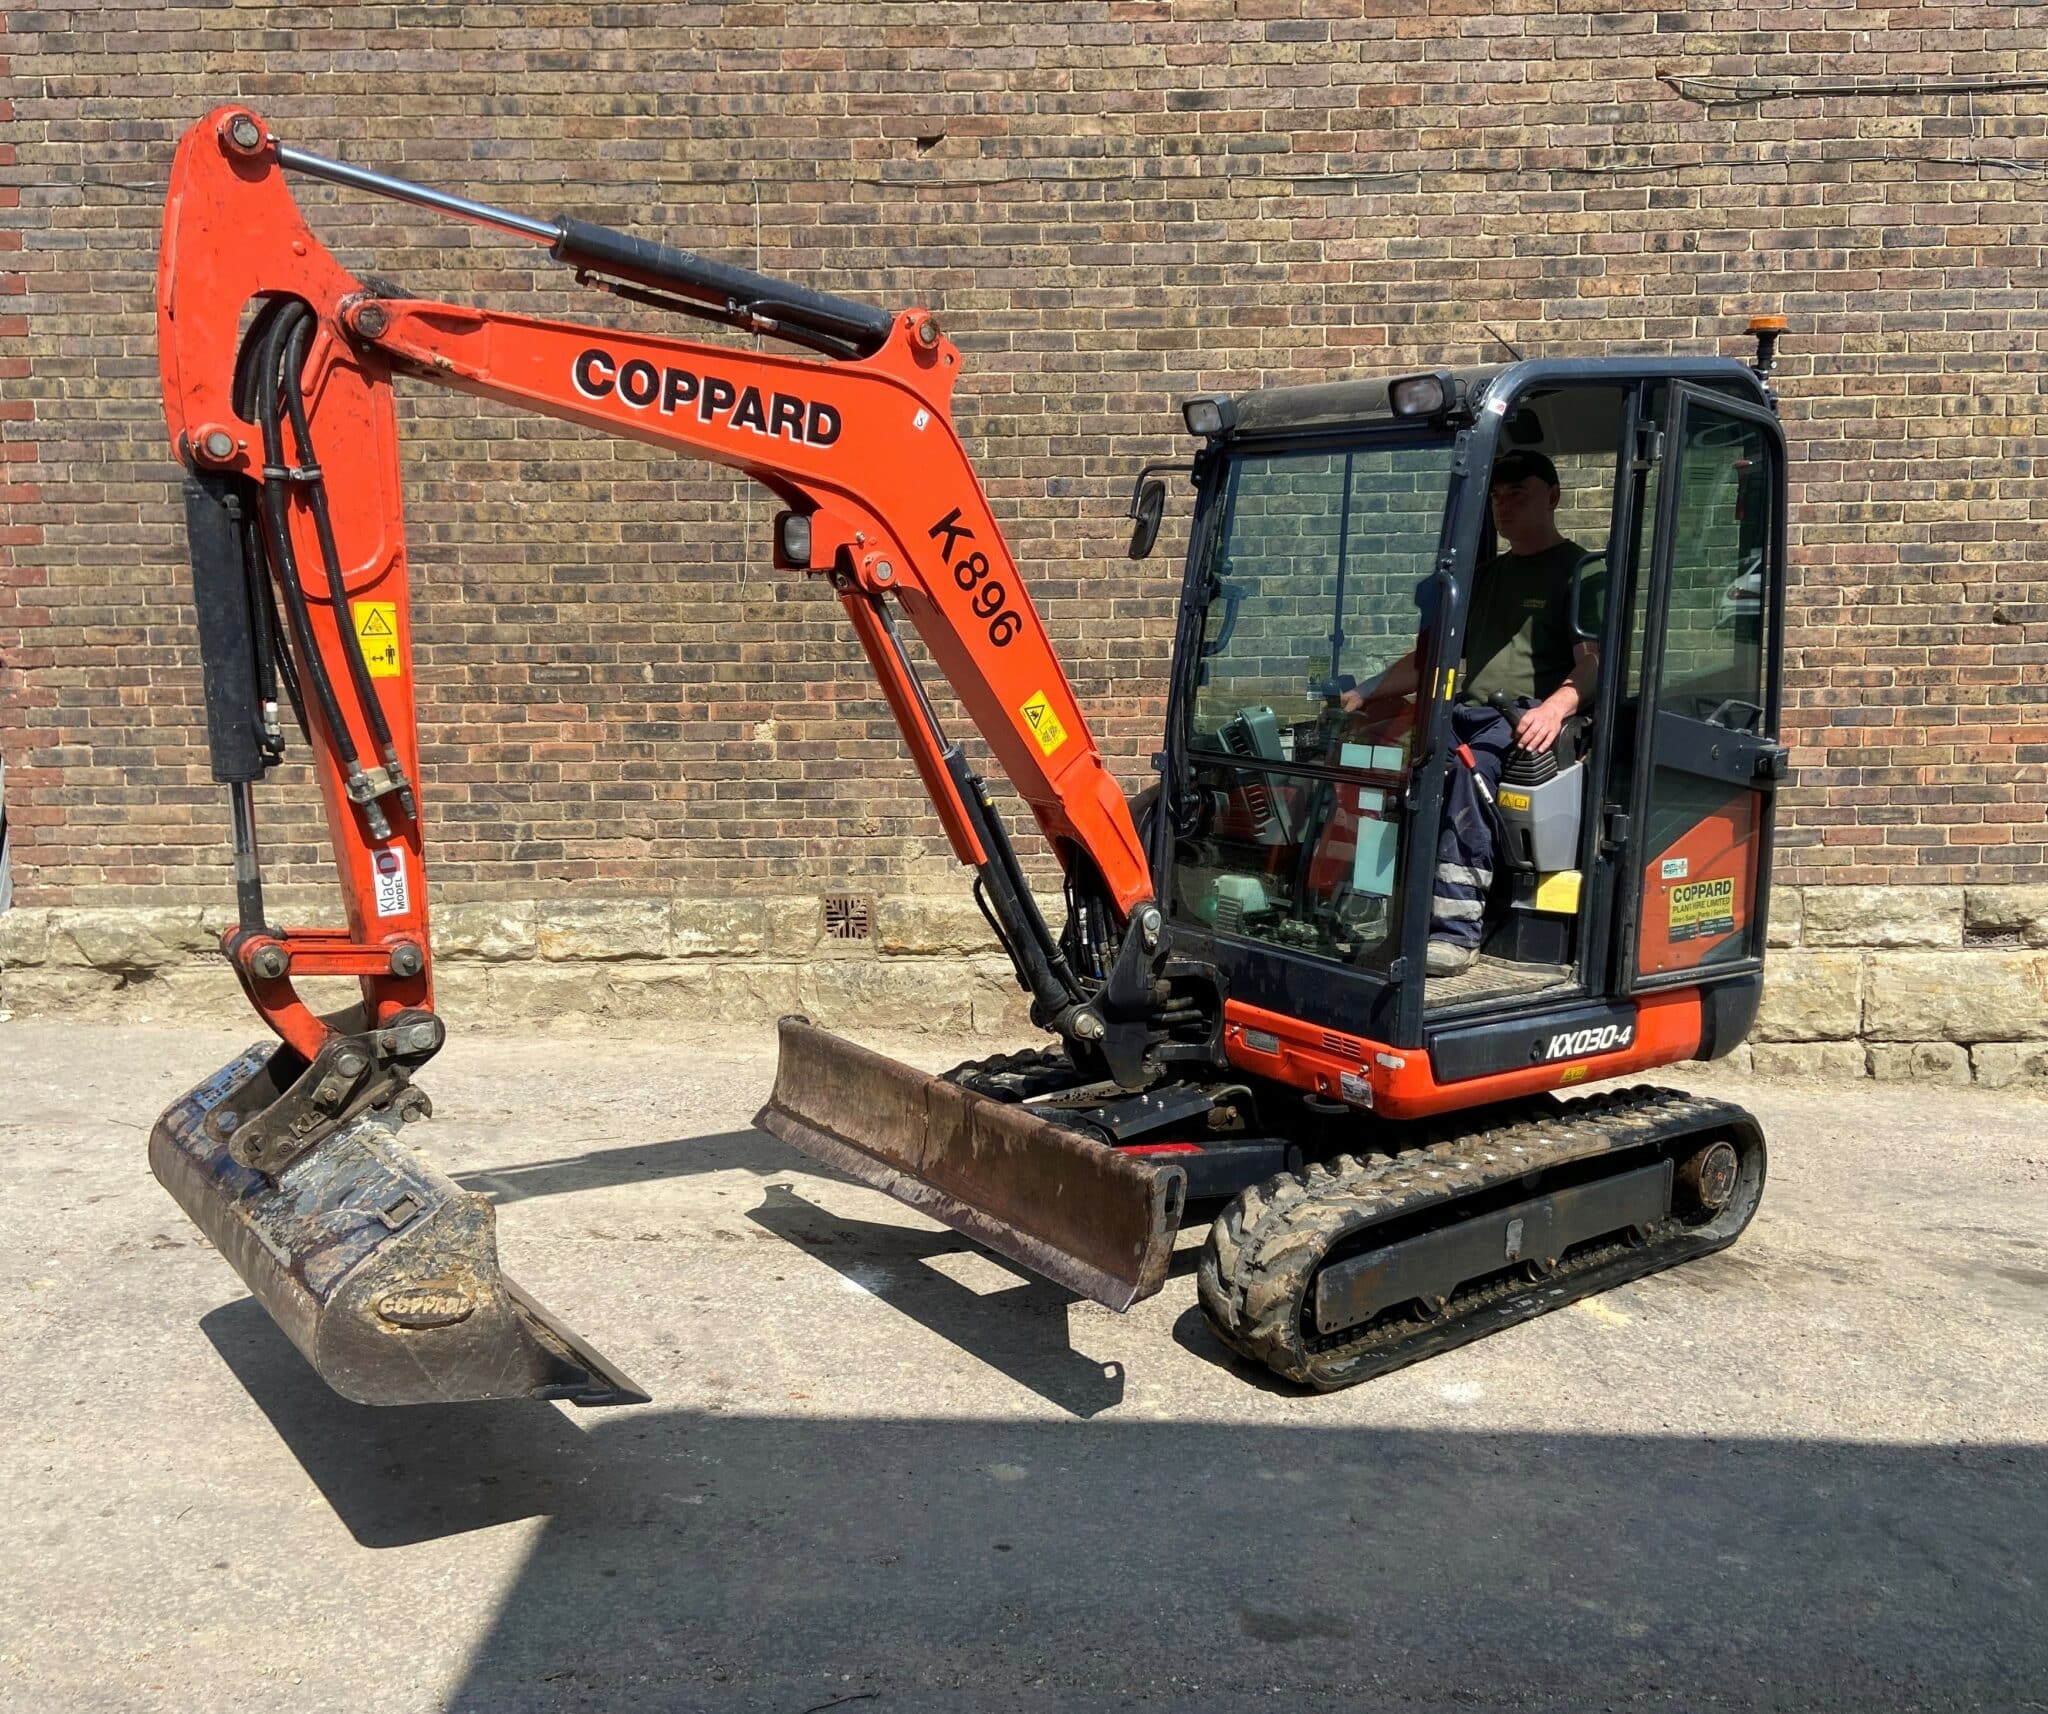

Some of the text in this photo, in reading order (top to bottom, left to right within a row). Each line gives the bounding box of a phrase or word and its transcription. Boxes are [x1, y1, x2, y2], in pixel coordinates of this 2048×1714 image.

[573, 349, 842, 448] COPPARD
[928, 507, 1023, 648] K896
[395, 877, 406, 910] MODEL
[1672, 904, 1692, 914] PLANT
[1706, 897, 1731, 908] LIMITED
[1673, 880, 1732, 903] COPPARD
[1546, 1025, 1632, 1059] KX030-4
